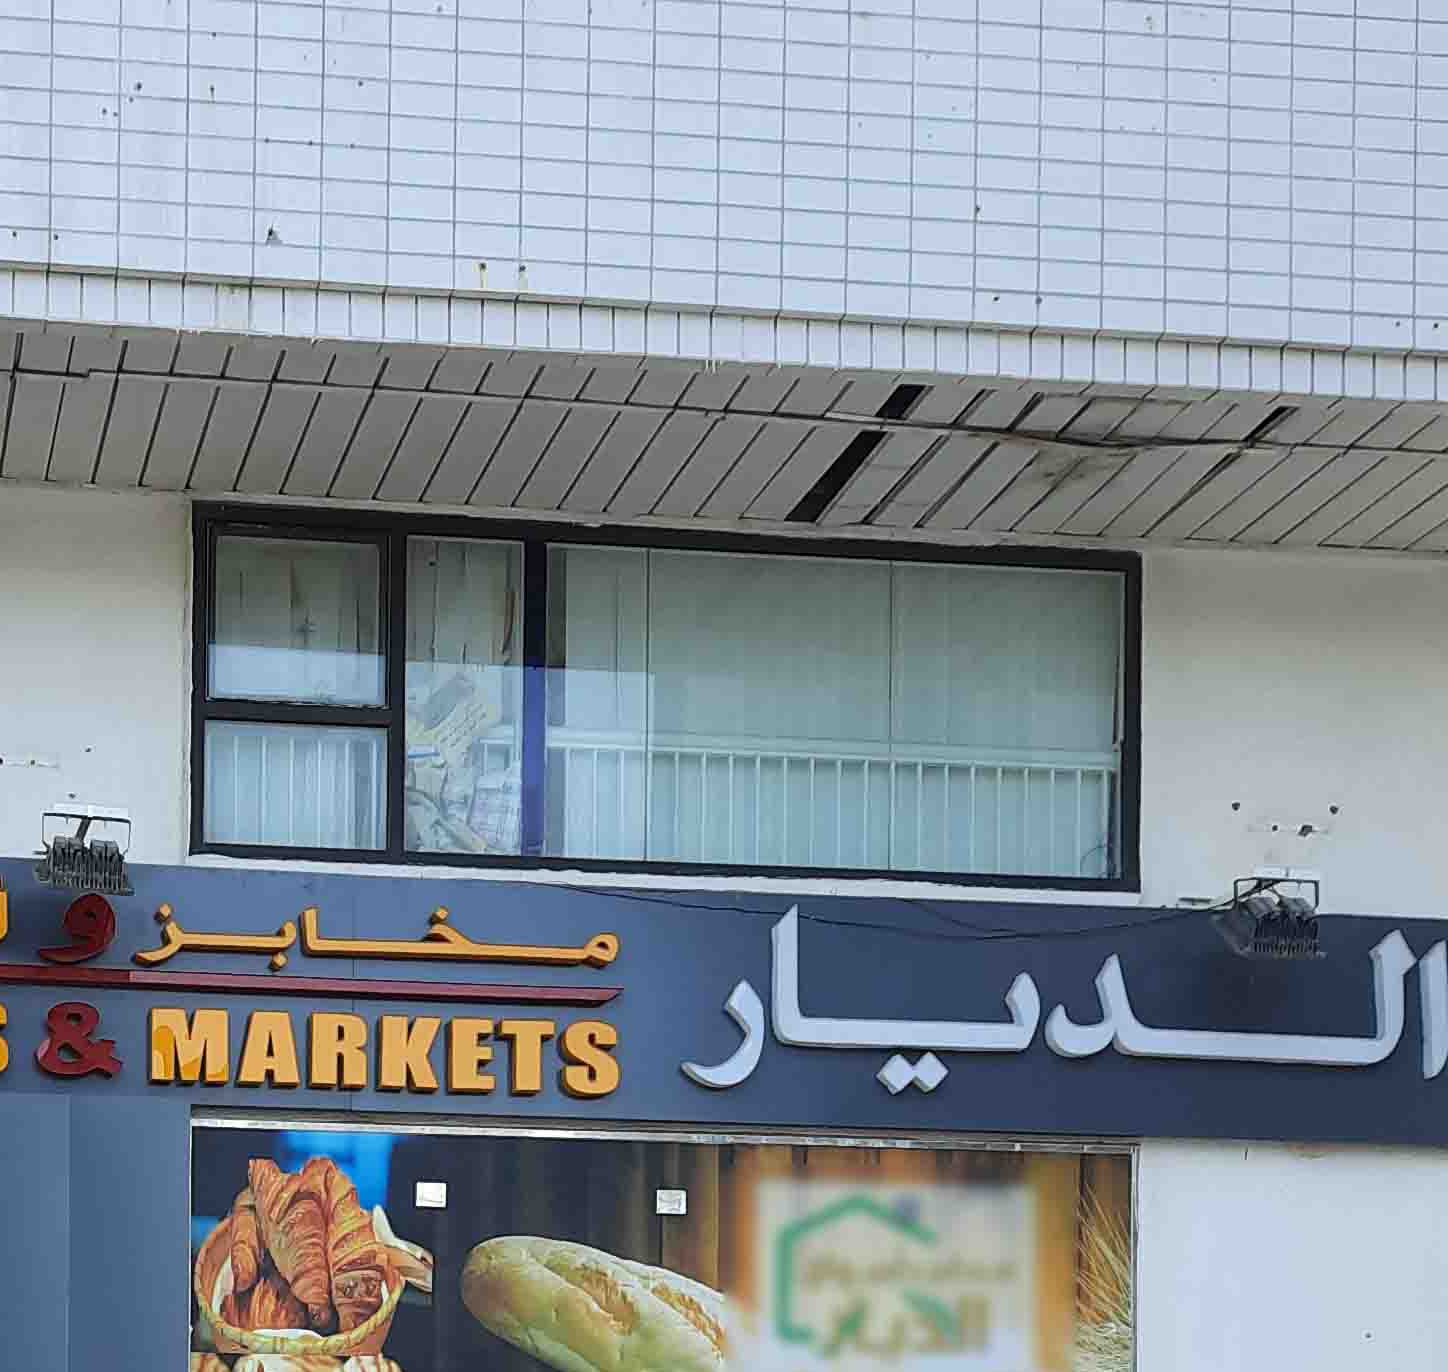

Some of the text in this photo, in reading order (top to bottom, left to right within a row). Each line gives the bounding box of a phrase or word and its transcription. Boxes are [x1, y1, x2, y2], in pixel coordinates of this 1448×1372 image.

[37, 892, 119, 963] و
[136, 903, 620, 971] مخابز
[680, 903, 1448, 1095] الديار
[37, 1001, 122, 1079] &
[150, 1006, 620, 1098] MARKETS
